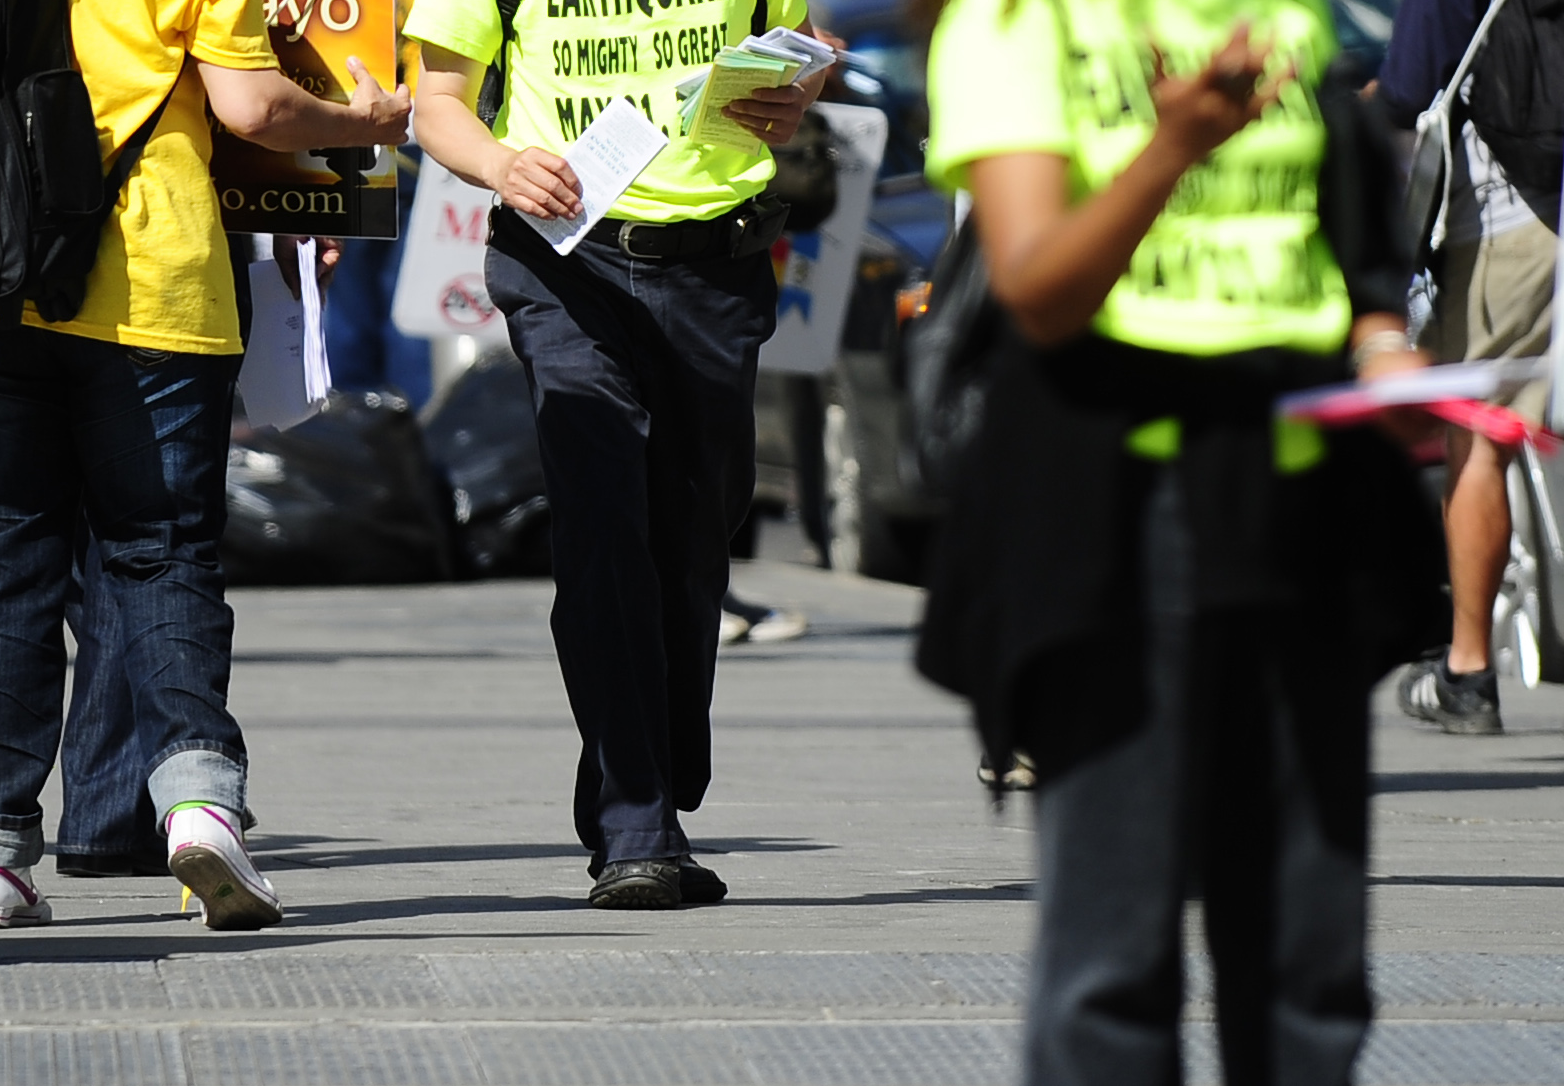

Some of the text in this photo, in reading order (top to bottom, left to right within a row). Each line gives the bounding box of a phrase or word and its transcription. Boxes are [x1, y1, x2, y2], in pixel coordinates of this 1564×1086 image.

[552, 38, 572, 77] SO
[577, 34, 639, 77] MIGHTY
[653, 30, 674, 70] SO
